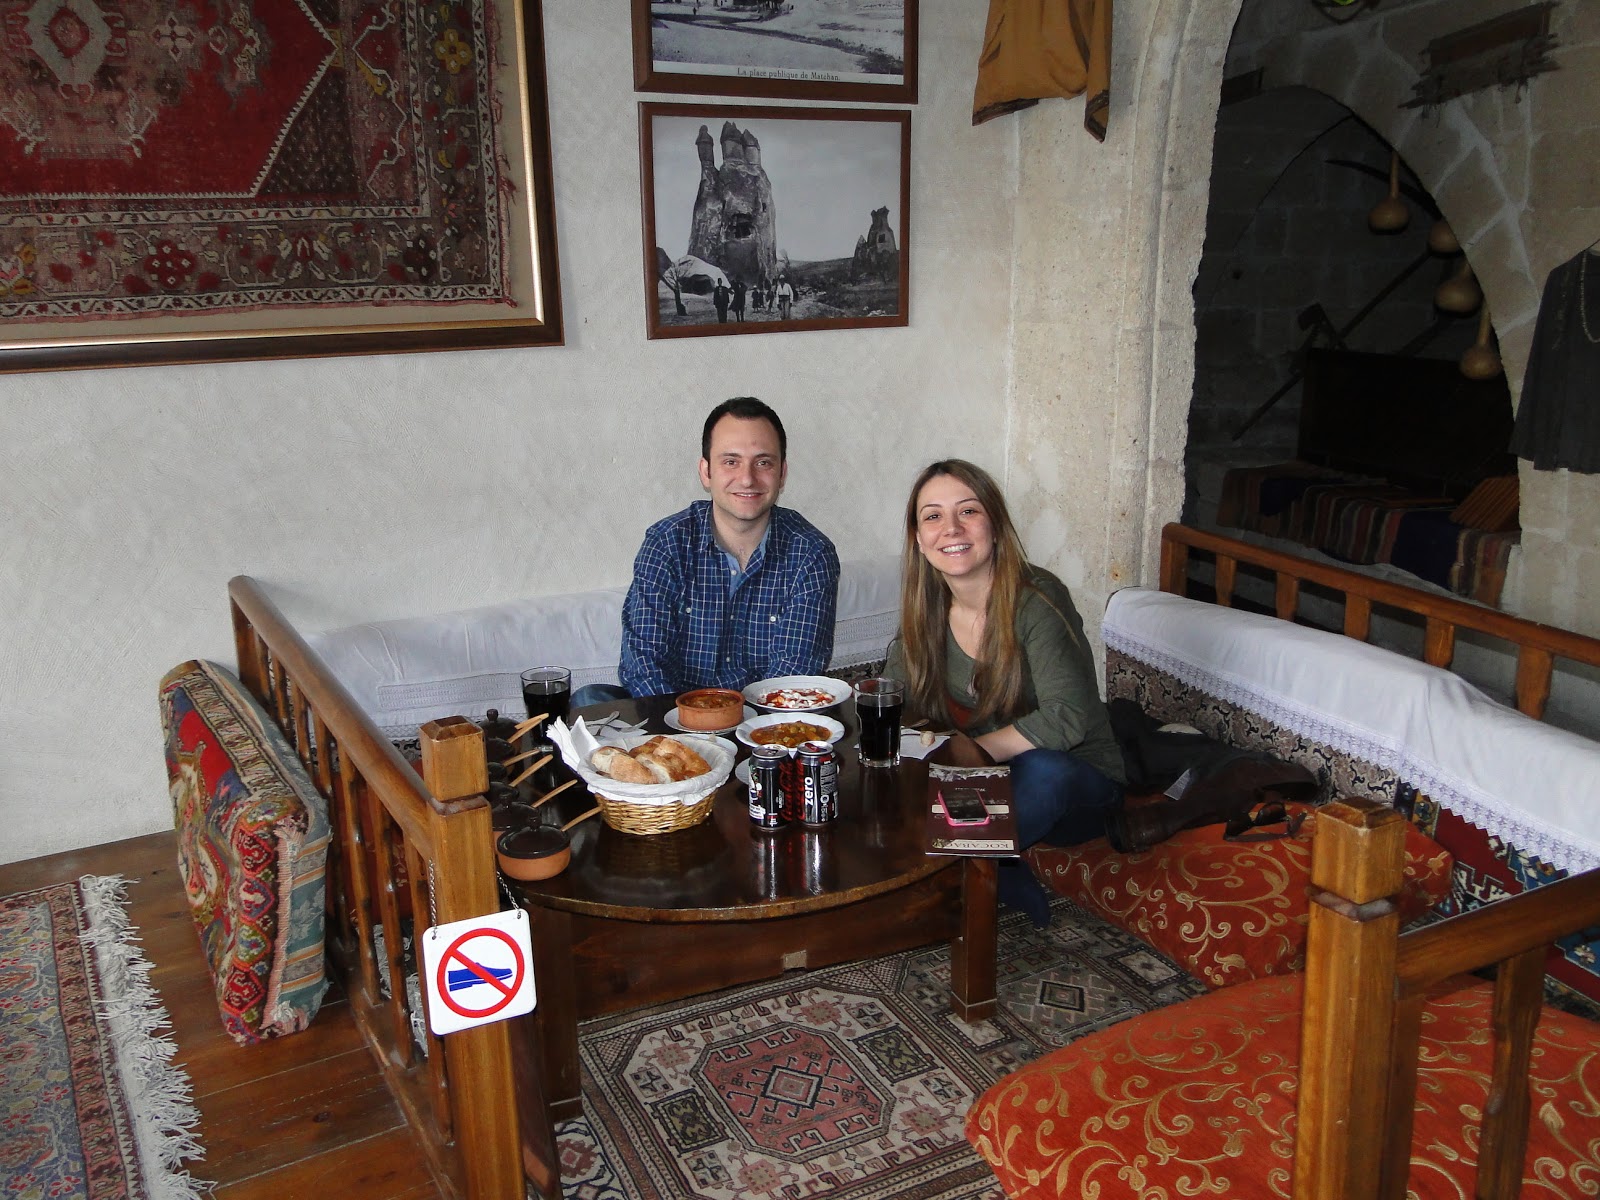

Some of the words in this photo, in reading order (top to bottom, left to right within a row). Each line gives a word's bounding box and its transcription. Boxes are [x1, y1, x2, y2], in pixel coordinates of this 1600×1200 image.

[737, 67, 747, 76] La
[749, 69, 767, 78] place
[768, 70, 798, 80] publique
[800, 71, 809, 79] de
[804, 777, 814, 806] zero
